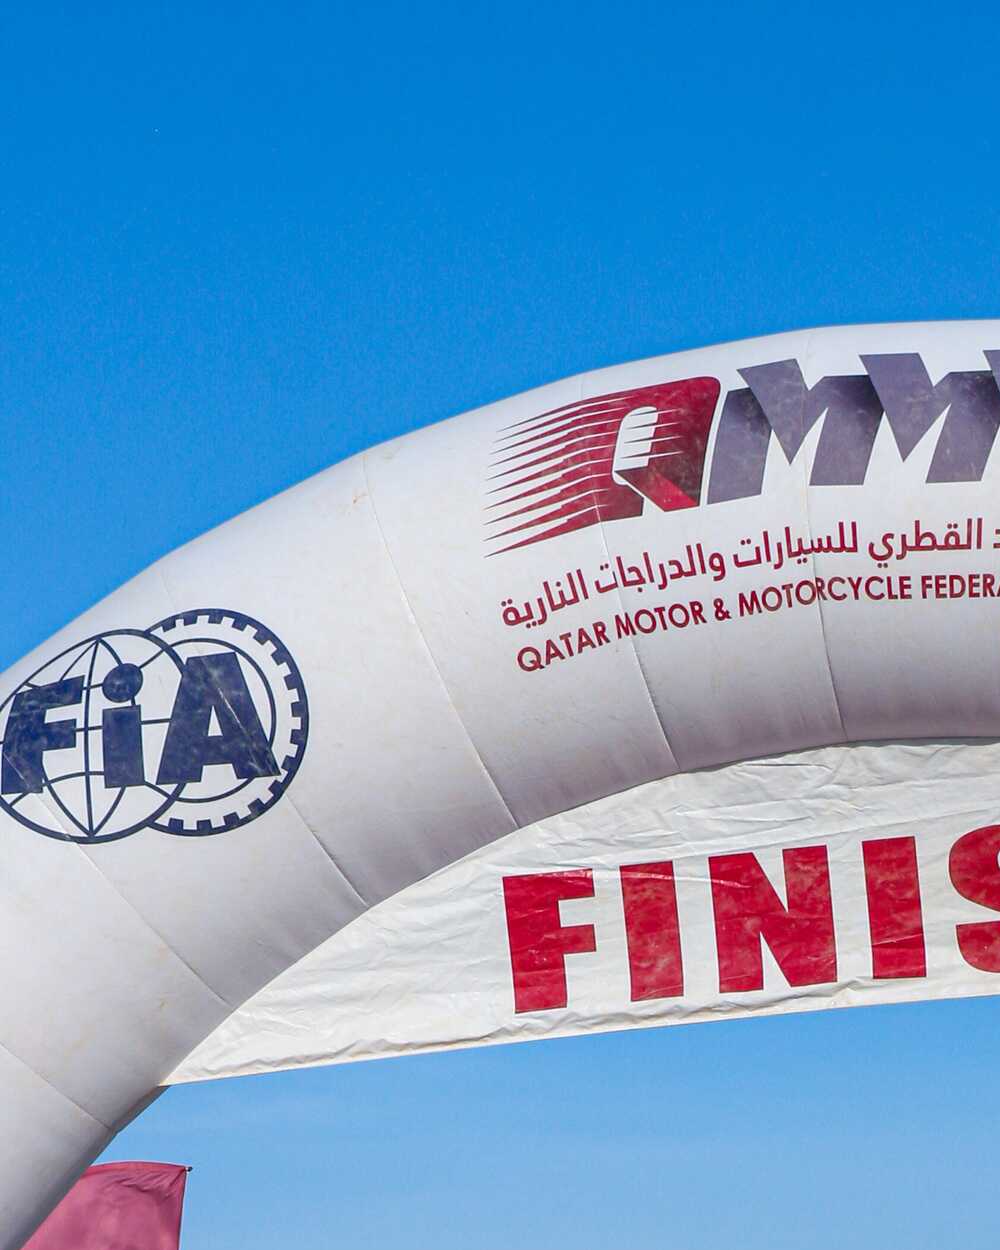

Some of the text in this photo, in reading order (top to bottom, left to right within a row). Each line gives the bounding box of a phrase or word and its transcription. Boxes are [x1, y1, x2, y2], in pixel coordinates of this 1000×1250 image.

[594, 543, 726, 594] والدراجات
[732, 520, 858, 570] للسيارات
[868, 517, 983, 569] القطري
[501, 568, 590, 629] النارية
[516, 620, 611, 673] QATAR
[614, 600, 708, 640] MOTOR
[713, 598, 732, 622] &
[738, 575, 912, 617] MOTORCYCLE
